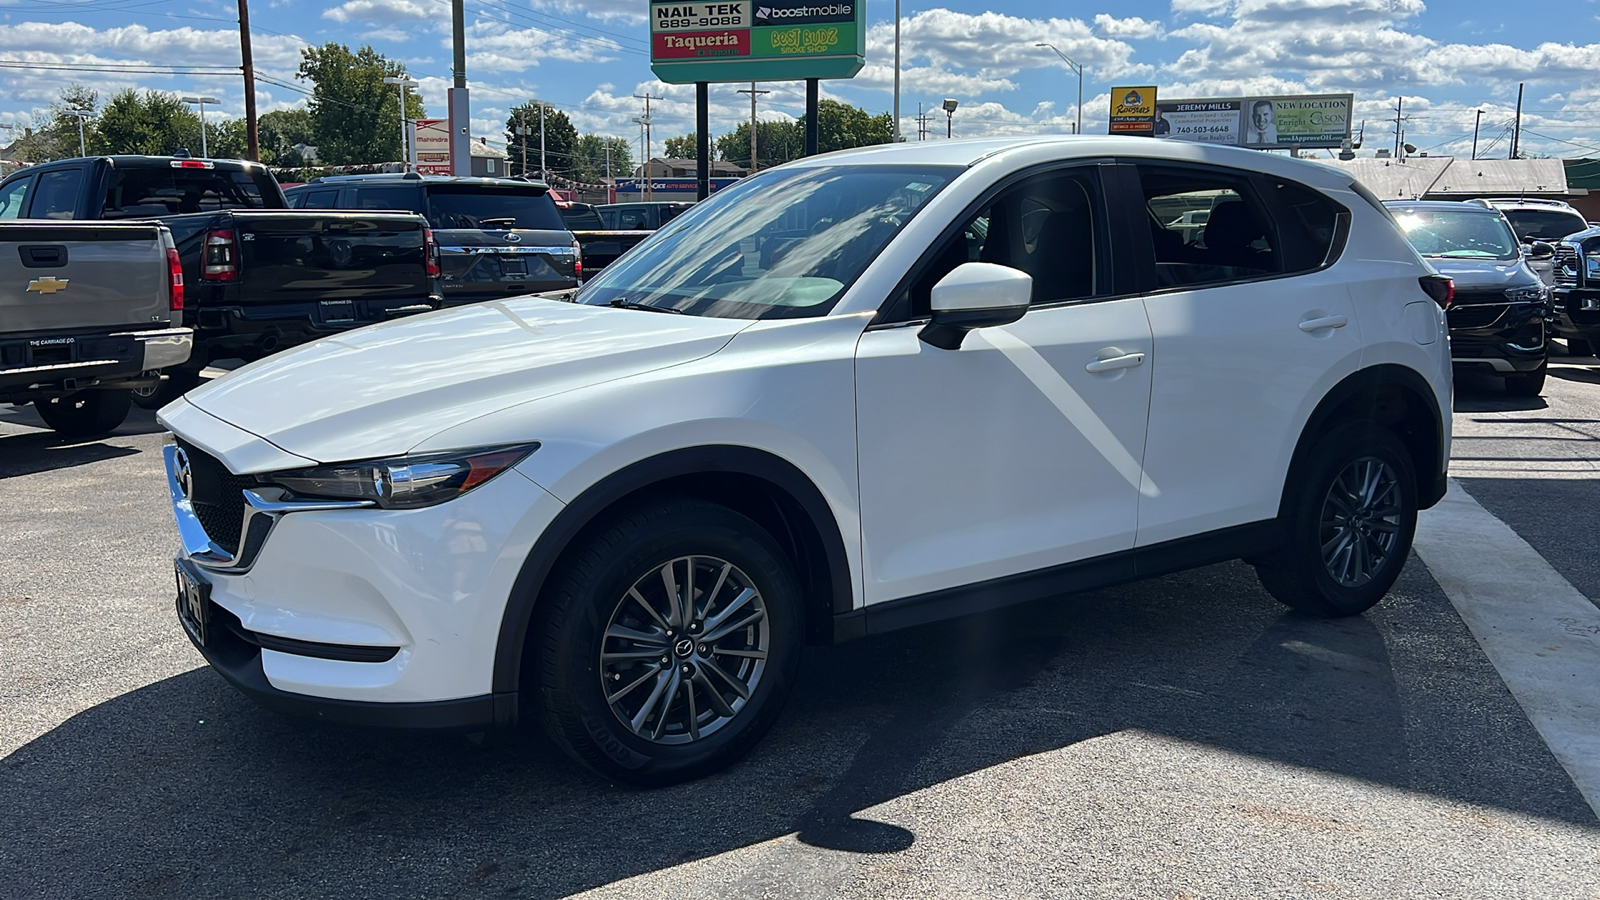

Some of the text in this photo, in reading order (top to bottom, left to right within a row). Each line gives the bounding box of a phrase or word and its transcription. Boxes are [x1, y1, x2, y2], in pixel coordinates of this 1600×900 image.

[657, 4, 742, 18] NAIL TEK
[772, 4, 851, 18] boostmobile
[659, 16, 741, 28] 689-9088
[781, 45, 828, 54] SMOKE SHOP
[1116, 104, 1150, 115] Roosters
[1299, 101, 1346, 109] LOCATION
[1278, 119, 1306, 127] Enright
[1176, 126, 1229, 134] 740-503-6648
